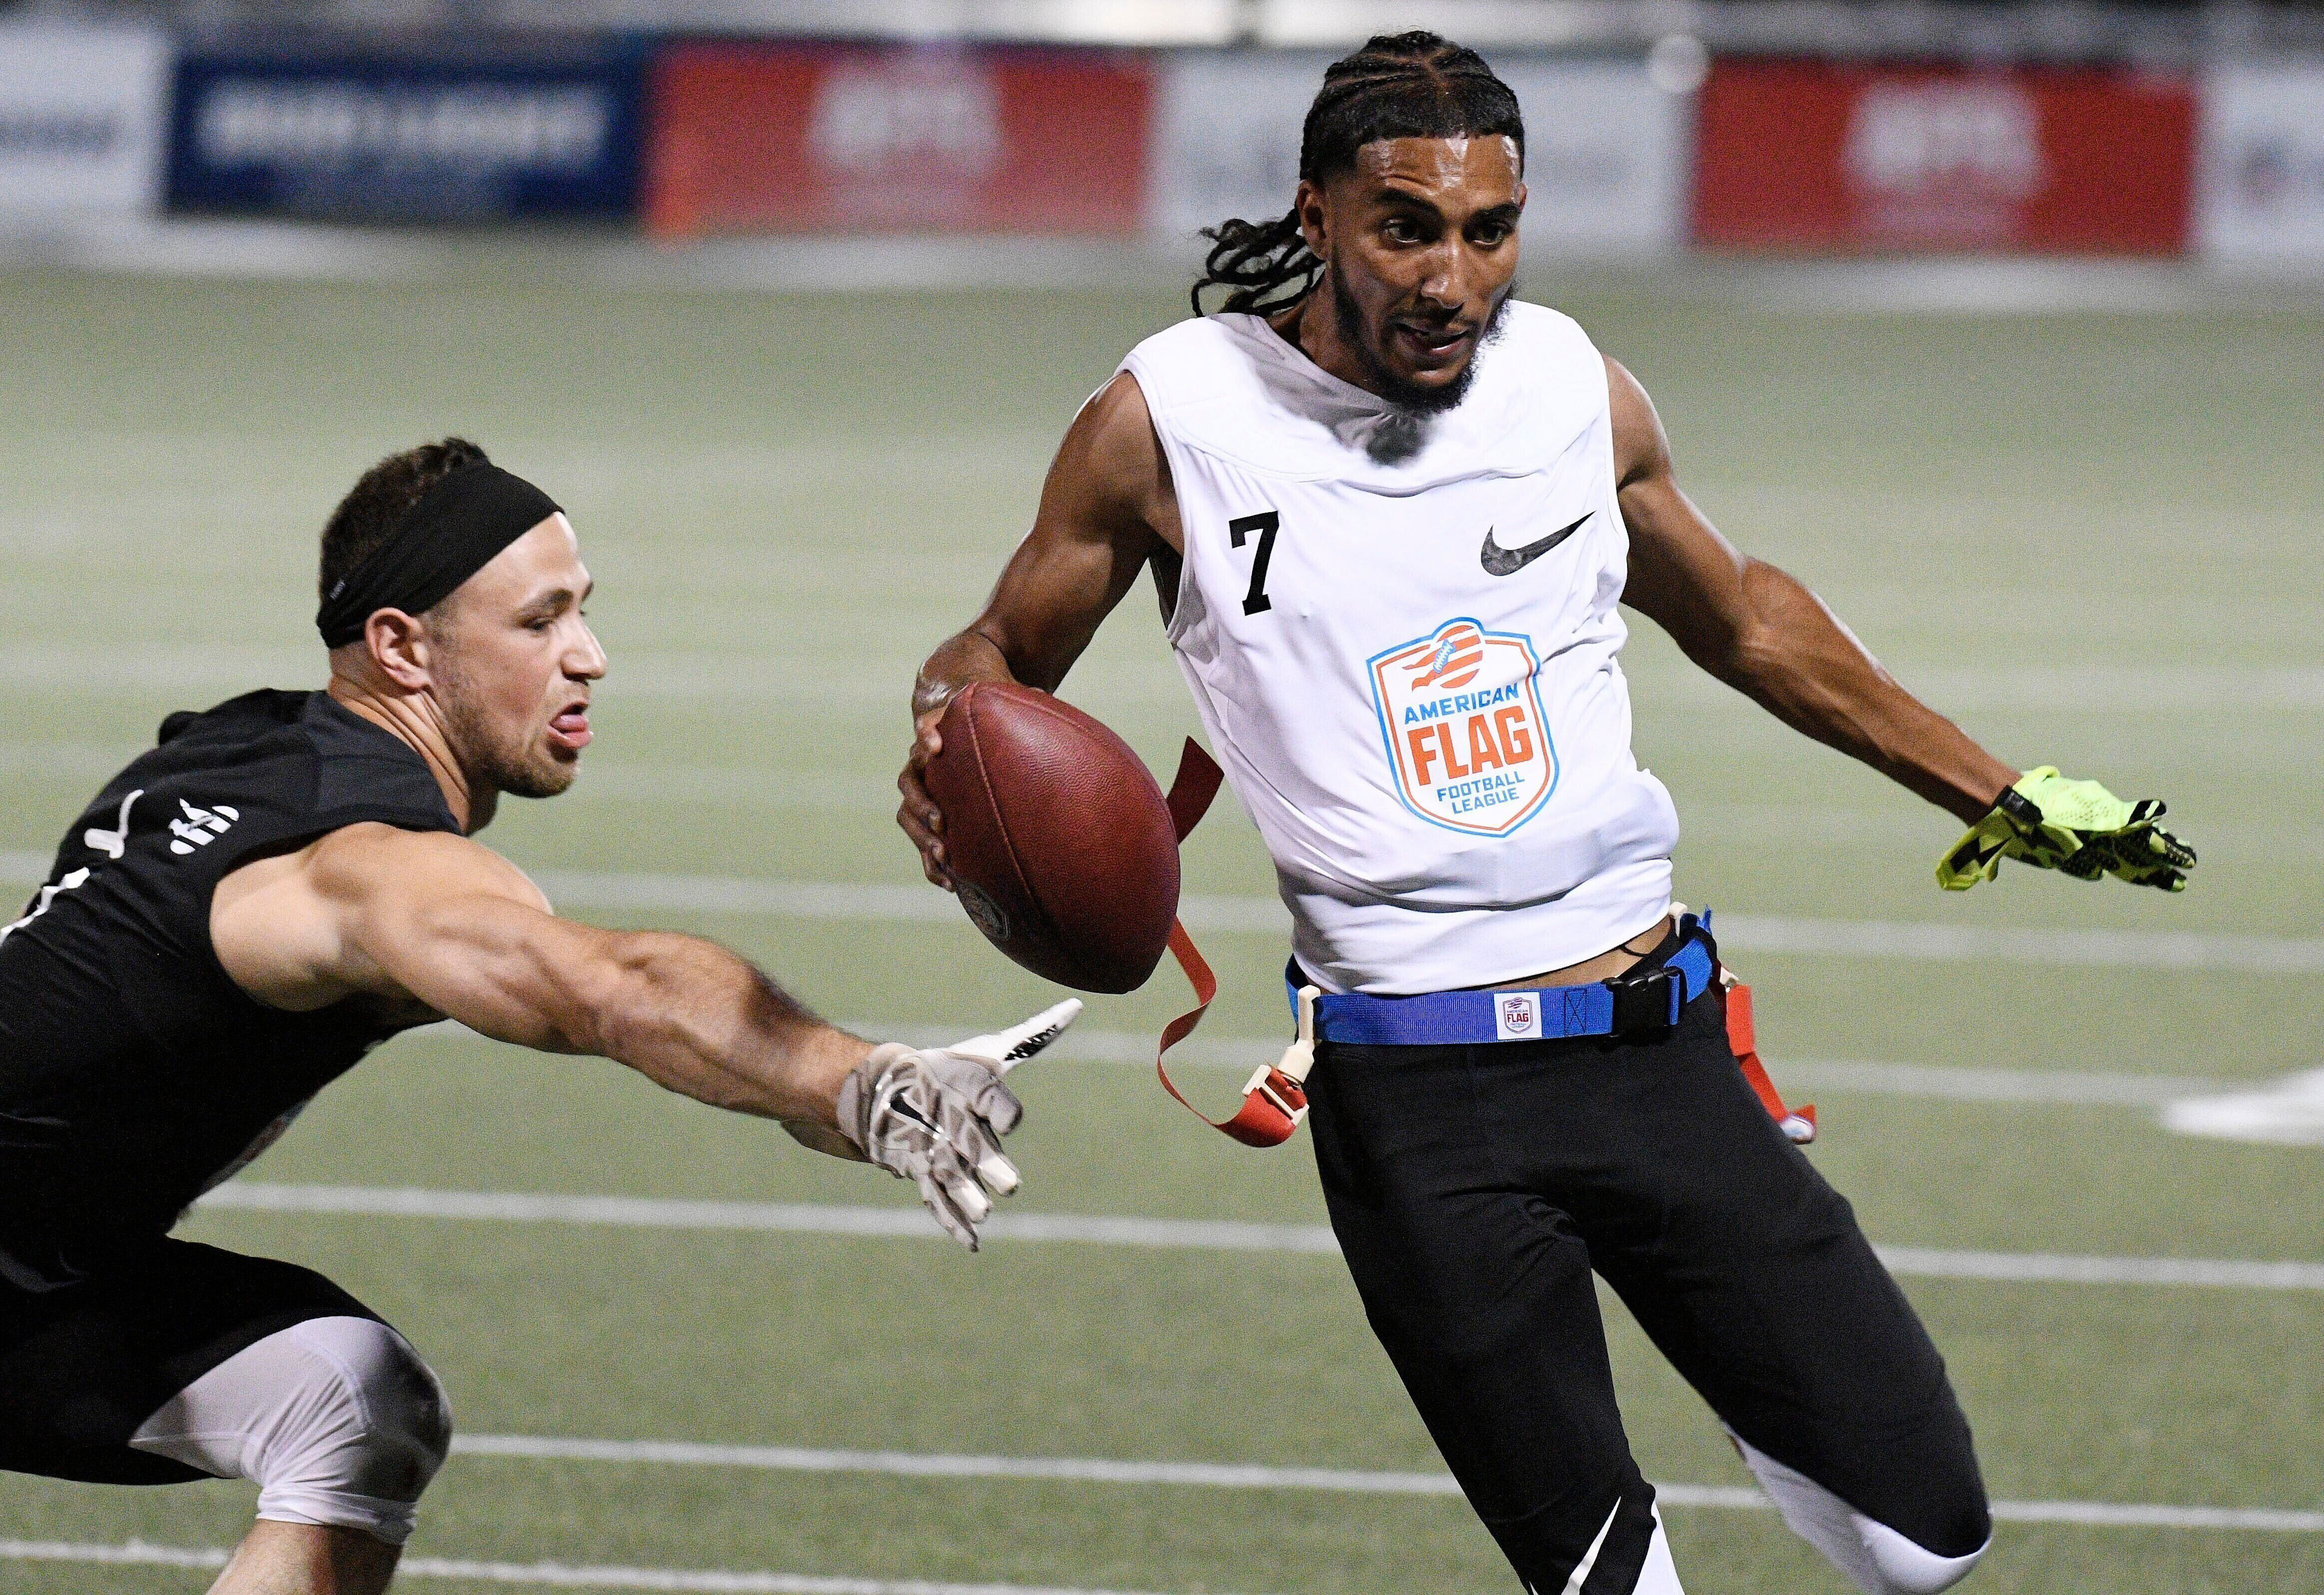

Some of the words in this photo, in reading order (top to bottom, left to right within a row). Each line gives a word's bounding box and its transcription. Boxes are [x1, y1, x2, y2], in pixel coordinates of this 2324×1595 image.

[1229, 511, 1279, 616] 7
[1404, 683, 1520, 725] AMERICAN
[1407, 706, 1534, 786] FLAG
[1437, 771, 1525, 801] FOOTBALL
[1452, 787, 1520, 814] LEAGUE
[1507, 1013, 1529, 1022] FLAG
